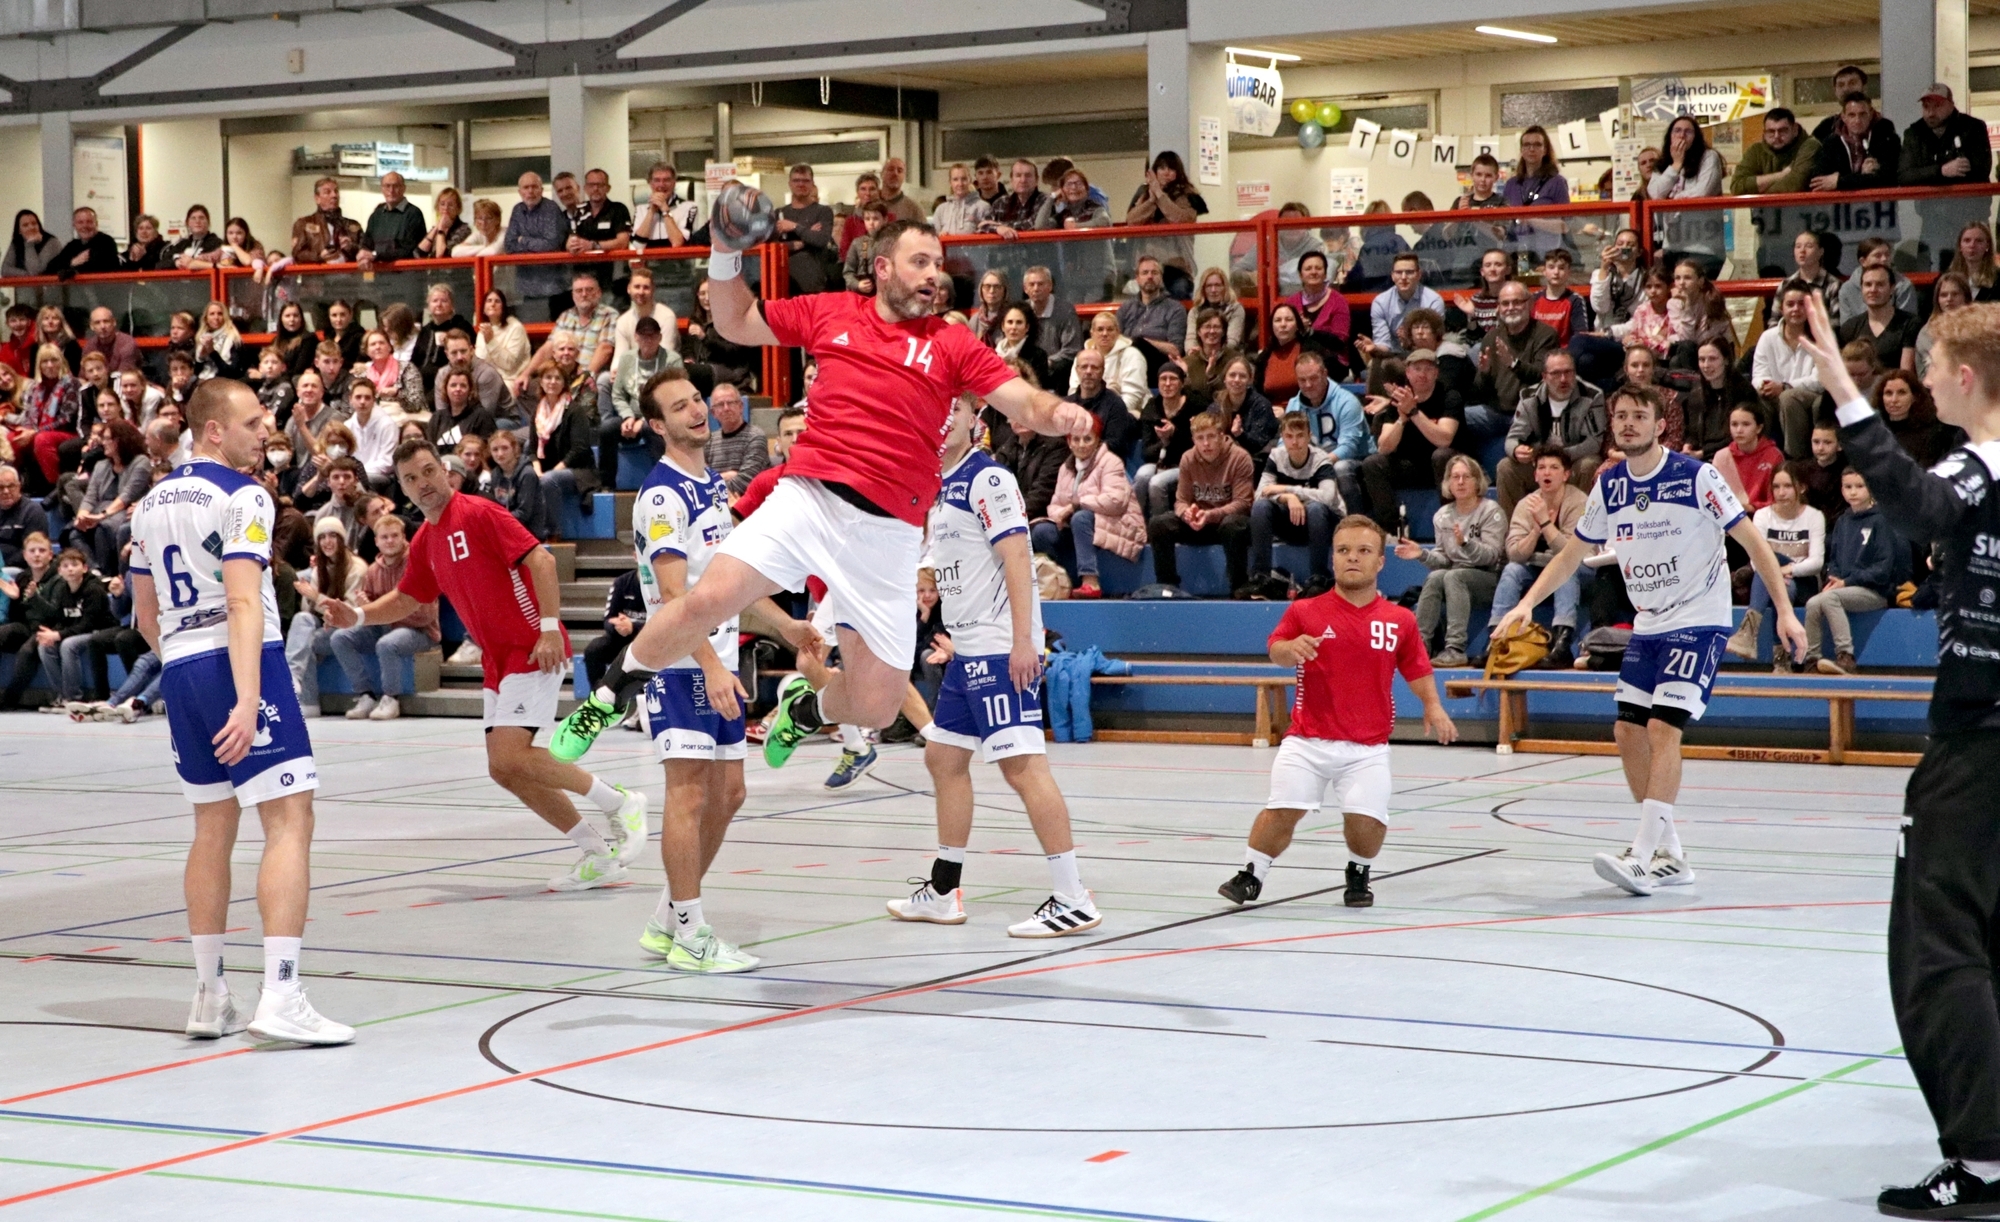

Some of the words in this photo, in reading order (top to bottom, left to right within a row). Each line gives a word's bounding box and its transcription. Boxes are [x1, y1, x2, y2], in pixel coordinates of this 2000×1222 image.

[1665, 82, 1738, 97] Handball
[1677, 100, 1728, 114] Aktive
[903, 337, 933, 374] 14
[158, 485, 213, 509] Schmiden
[1608, 477, 1628, 507] 20
[1636, 519, 1671, 530] Volksbank
[1636, 529, 1669, 540] Stuttgart
[1670, 527, 1682, 536] eG
[1778, 531, 1799, 541] LIVE
[447, 530, 470, 562] 13
[163, 544, 199, 608] 6
[1632, 555, 1679, 579] conf
[1626, 575, 1680, 593] industries
[1370, 620, 1399, 652] 95
[1663, 648, 1698, 679] 20
[691, 673, 706, 707] KÜCHE
[1663, 691, 1686, 701] Kempa
[982, 693, 1012, 728] 10
[992, 742, 1014, 752] Kempa
